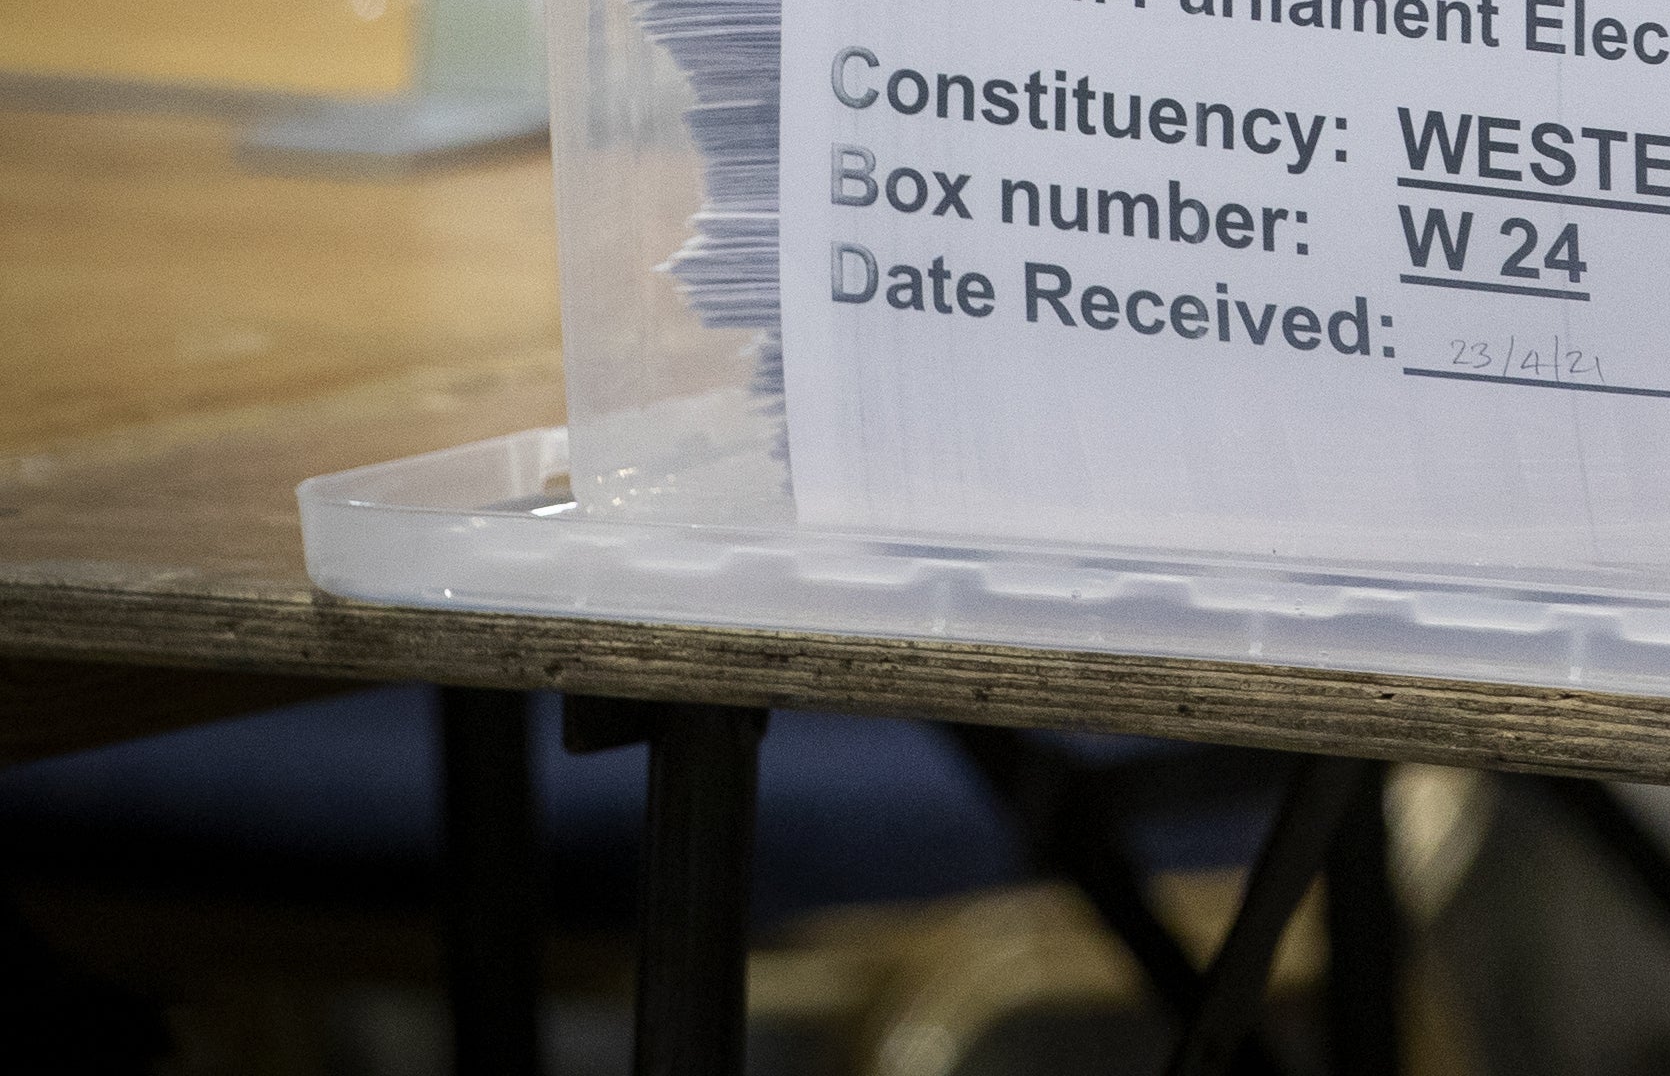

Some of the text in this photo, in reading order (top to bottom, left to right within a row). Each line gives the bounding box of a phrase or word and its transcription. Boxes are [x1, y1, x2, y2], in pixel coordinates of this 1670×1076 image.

[829, 44, 1349, 176] Constituency:
[830, 142, 1588, 284] Box number: W 24
[830, 240, 1396, 359] Date Received:
[1450, 334, 1605, 382] 23/4/21
